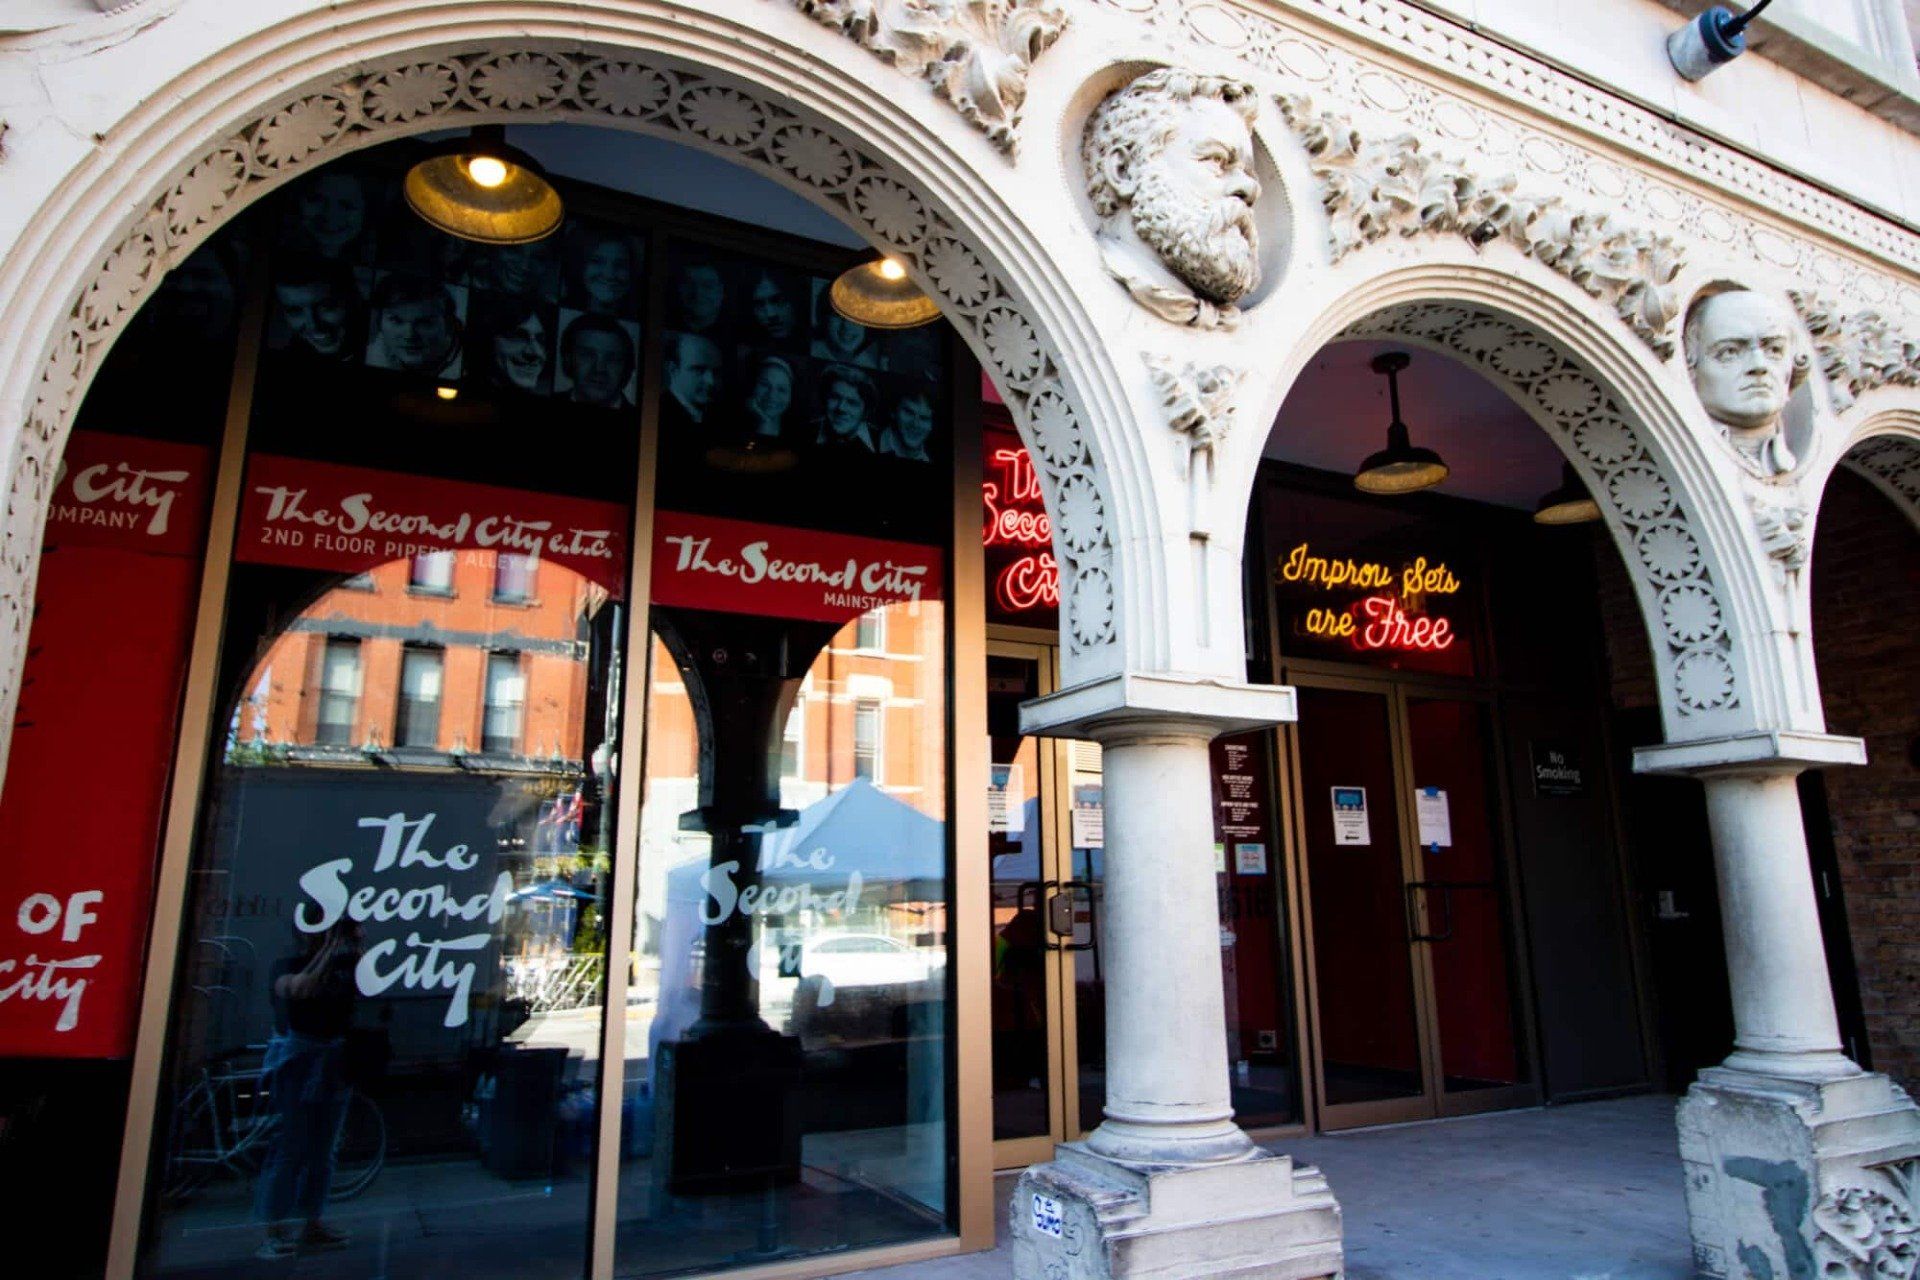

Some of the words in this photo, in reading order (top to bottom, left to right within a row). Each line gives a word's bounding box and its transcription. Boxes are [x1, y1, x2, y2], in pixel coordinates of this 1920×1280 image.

[47, 505, 139, 530] OMPANY
[72, 462, 190, 535] City
[255, 486, 336, 526] The
[337, 493, 471, 543] Second
[475, 515, 552, 571] City
[983, 483, 1052, 546] Seco
[261, 526, 304, 547] 2ND
[314, 533, 376, 555] FLOOR
[1283, 543, 1392, 590] Improv
[1402, 556, 1460, 599] Sets
[665, 535, 738, 576] The
[740, 541, 857, 590] Second
[860, 560, 928, 617] City
[1306, 608, 1356, 636] are
[1364, 596, 1454, 649] Free
[358, 812, 479, 873] The
[740, 820, 835, 872] The
[17, 890, 104, 942] OF
[295, 858, 513, 933] Second
[699, 860, 863, 925] Second
[355, 932, 492, 1028] City
